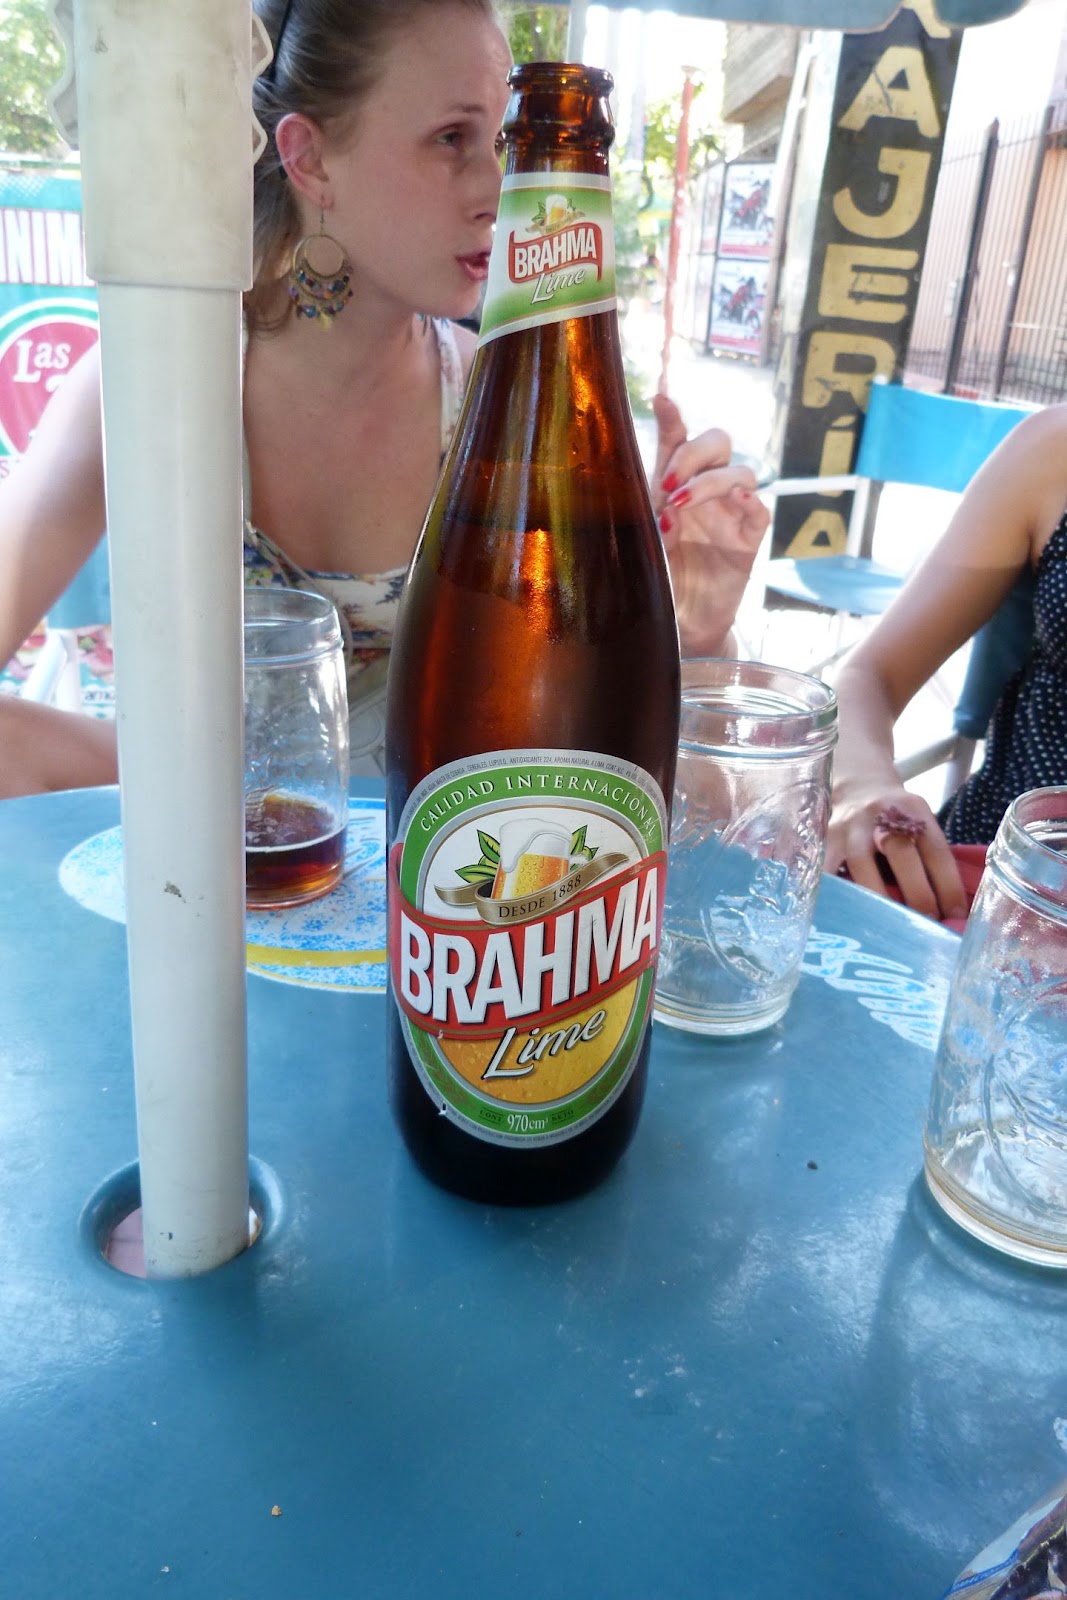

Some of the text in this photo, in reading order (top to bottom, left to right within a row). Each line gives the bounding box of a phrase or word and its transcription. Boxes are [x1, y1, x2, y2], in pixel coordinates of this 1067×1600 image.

[0, 208, 97, 287] NIM
[514, 228, 597, 279] BRAHMA
[531, 268, 585, 305] Lime
[784, 0, 951, 559] AJERÍA
[13, 340, 71, 384] Las
[420, 780, 495, 832] CALIDAD
[505, 774, 657, 837] INTERNACIONAL
[498, 874, 582, 918] DESDE 1888
[400, 867, 659, 1024] BRAHMA
[481, 1009, 607, 1080] Lime
[551, 1109, 574, 1121] NETO
